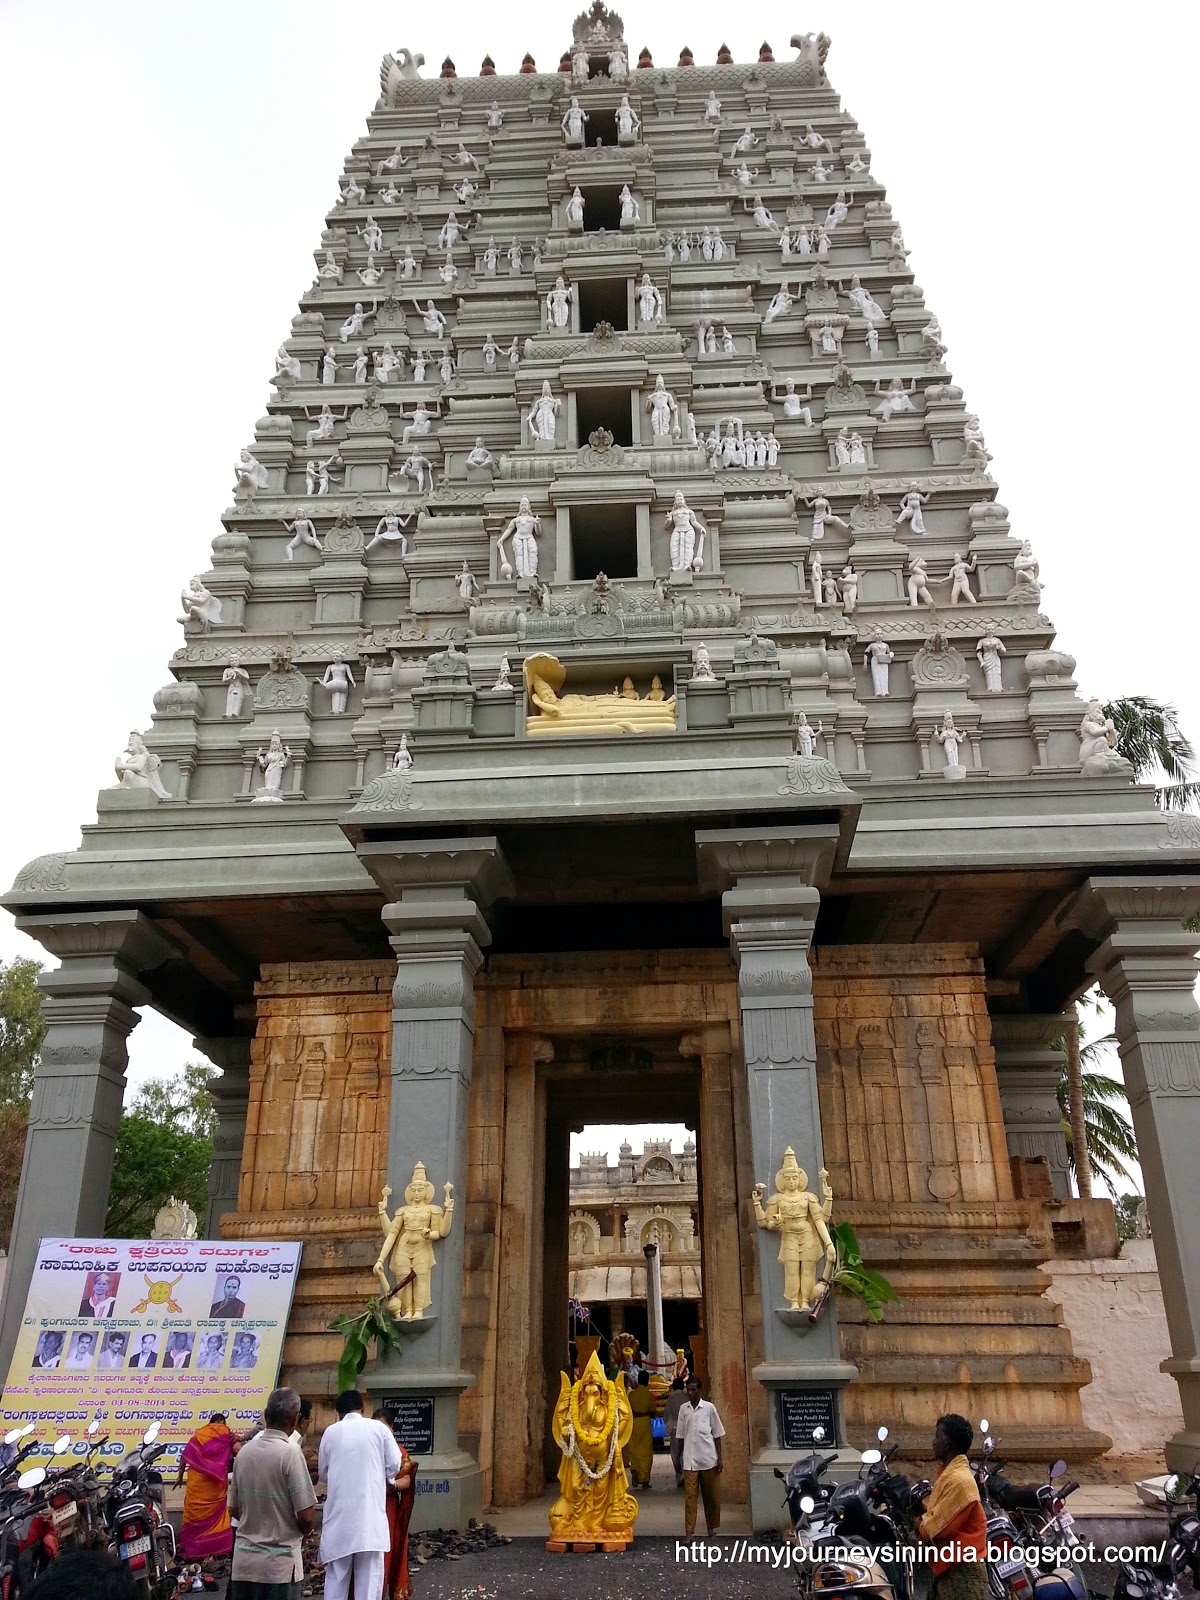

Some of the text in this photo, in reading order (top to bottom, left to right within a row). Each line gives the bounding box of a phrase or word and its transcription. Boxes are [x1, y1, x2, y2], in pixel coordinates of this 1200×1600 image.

[39, 1259, 295, 1280] ಸಾಮೂಹಿಕ ಉಪನಯನ ಮಹೋತ್ಸವ
